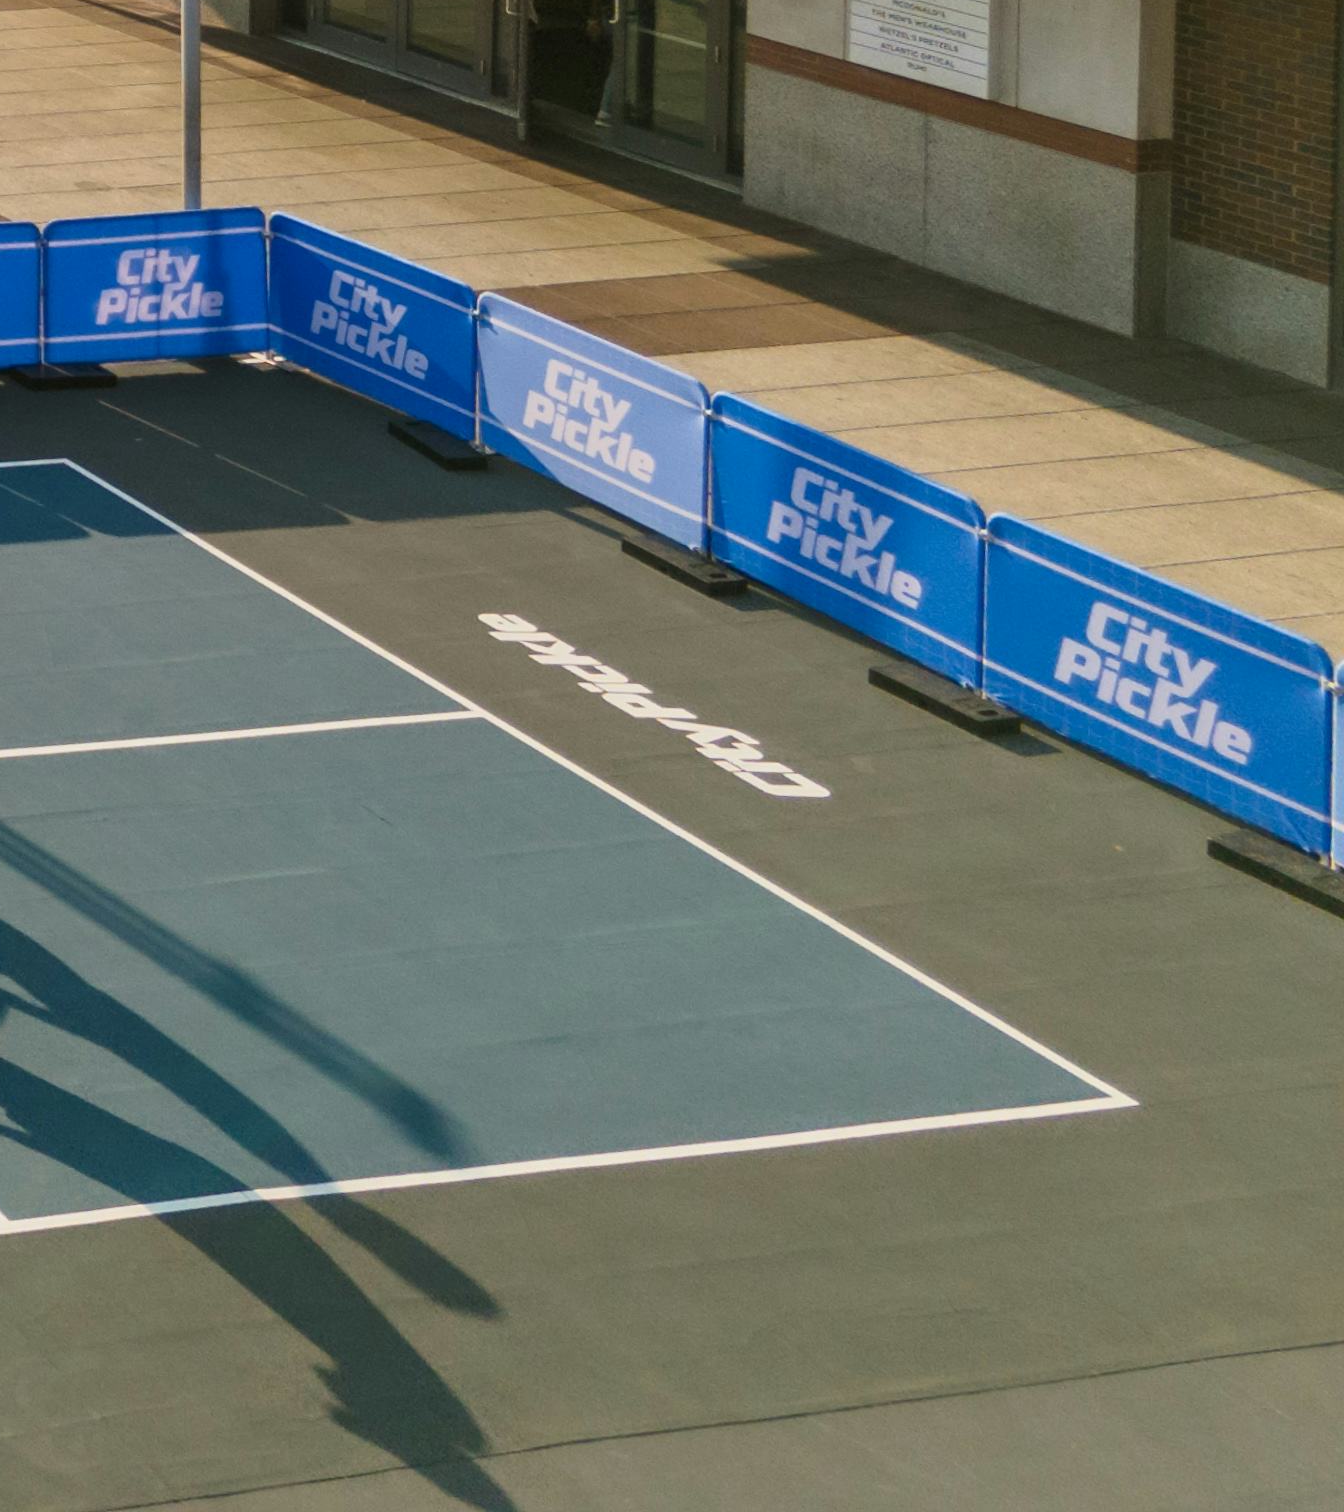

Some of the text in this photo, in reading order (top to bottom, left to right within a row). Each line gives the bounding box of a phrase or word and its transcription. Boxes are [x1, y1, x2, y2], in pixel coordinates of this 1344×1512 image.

[96, 284, 224, 325] Pickle
[116, 248, 202, 293] City
[328, 269, 407, 328] City
[311, 299, 429, 381] Pickle
[543, 357, 632, 431] City
[523, 389, 656, 485] Pickle
[791, 467, 894, 551] City
[767, 501, 923, 611] Pickle
[1085, 601, 1220, 698] City
[1054, 637, 1253, 765] Pickle
